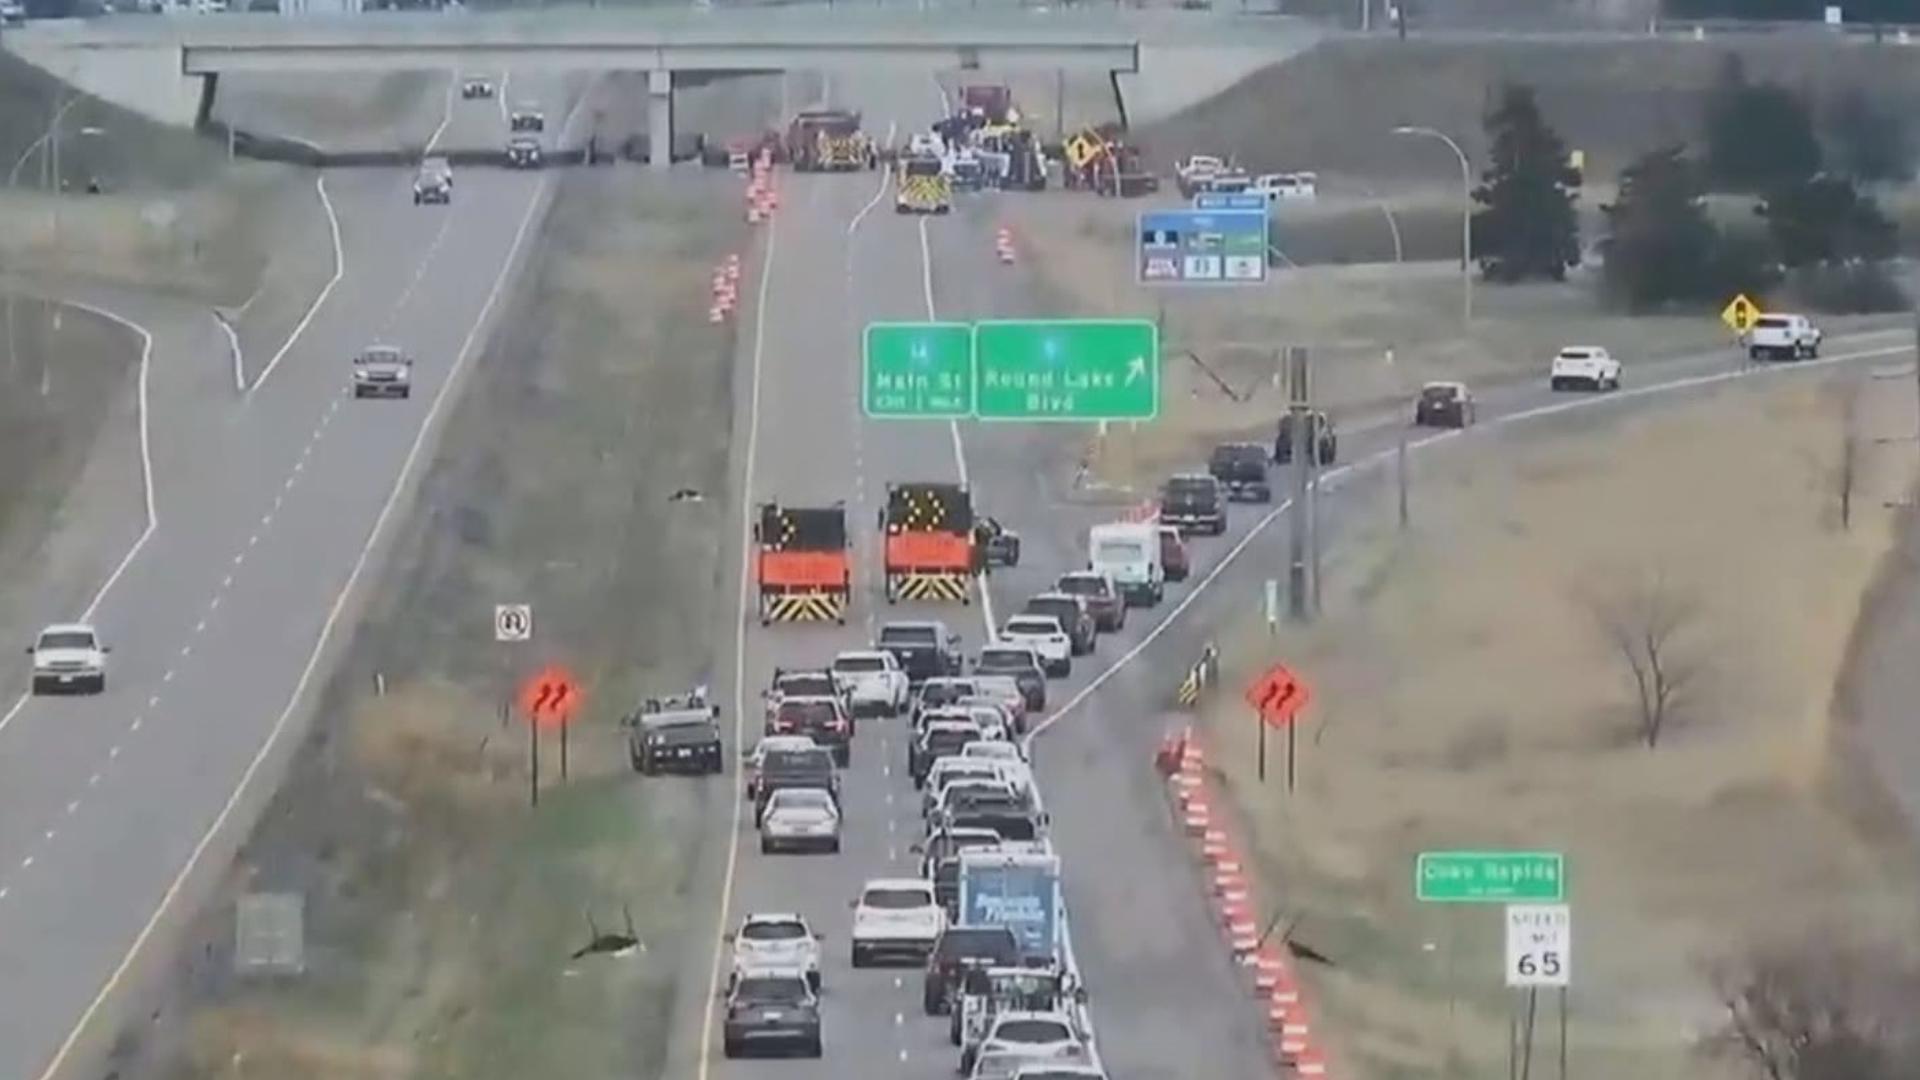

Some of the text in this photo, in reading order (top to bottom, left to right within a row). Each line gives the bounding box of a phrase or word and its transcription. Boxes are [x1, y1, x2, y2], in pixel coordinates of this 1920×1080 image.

[876, 371, 928, 388] Main
[985, 370, 1114, 388] Round Lake
[1026, 393, 1074, 411] Blvd
[1518, 951, 1561, 976] 65
